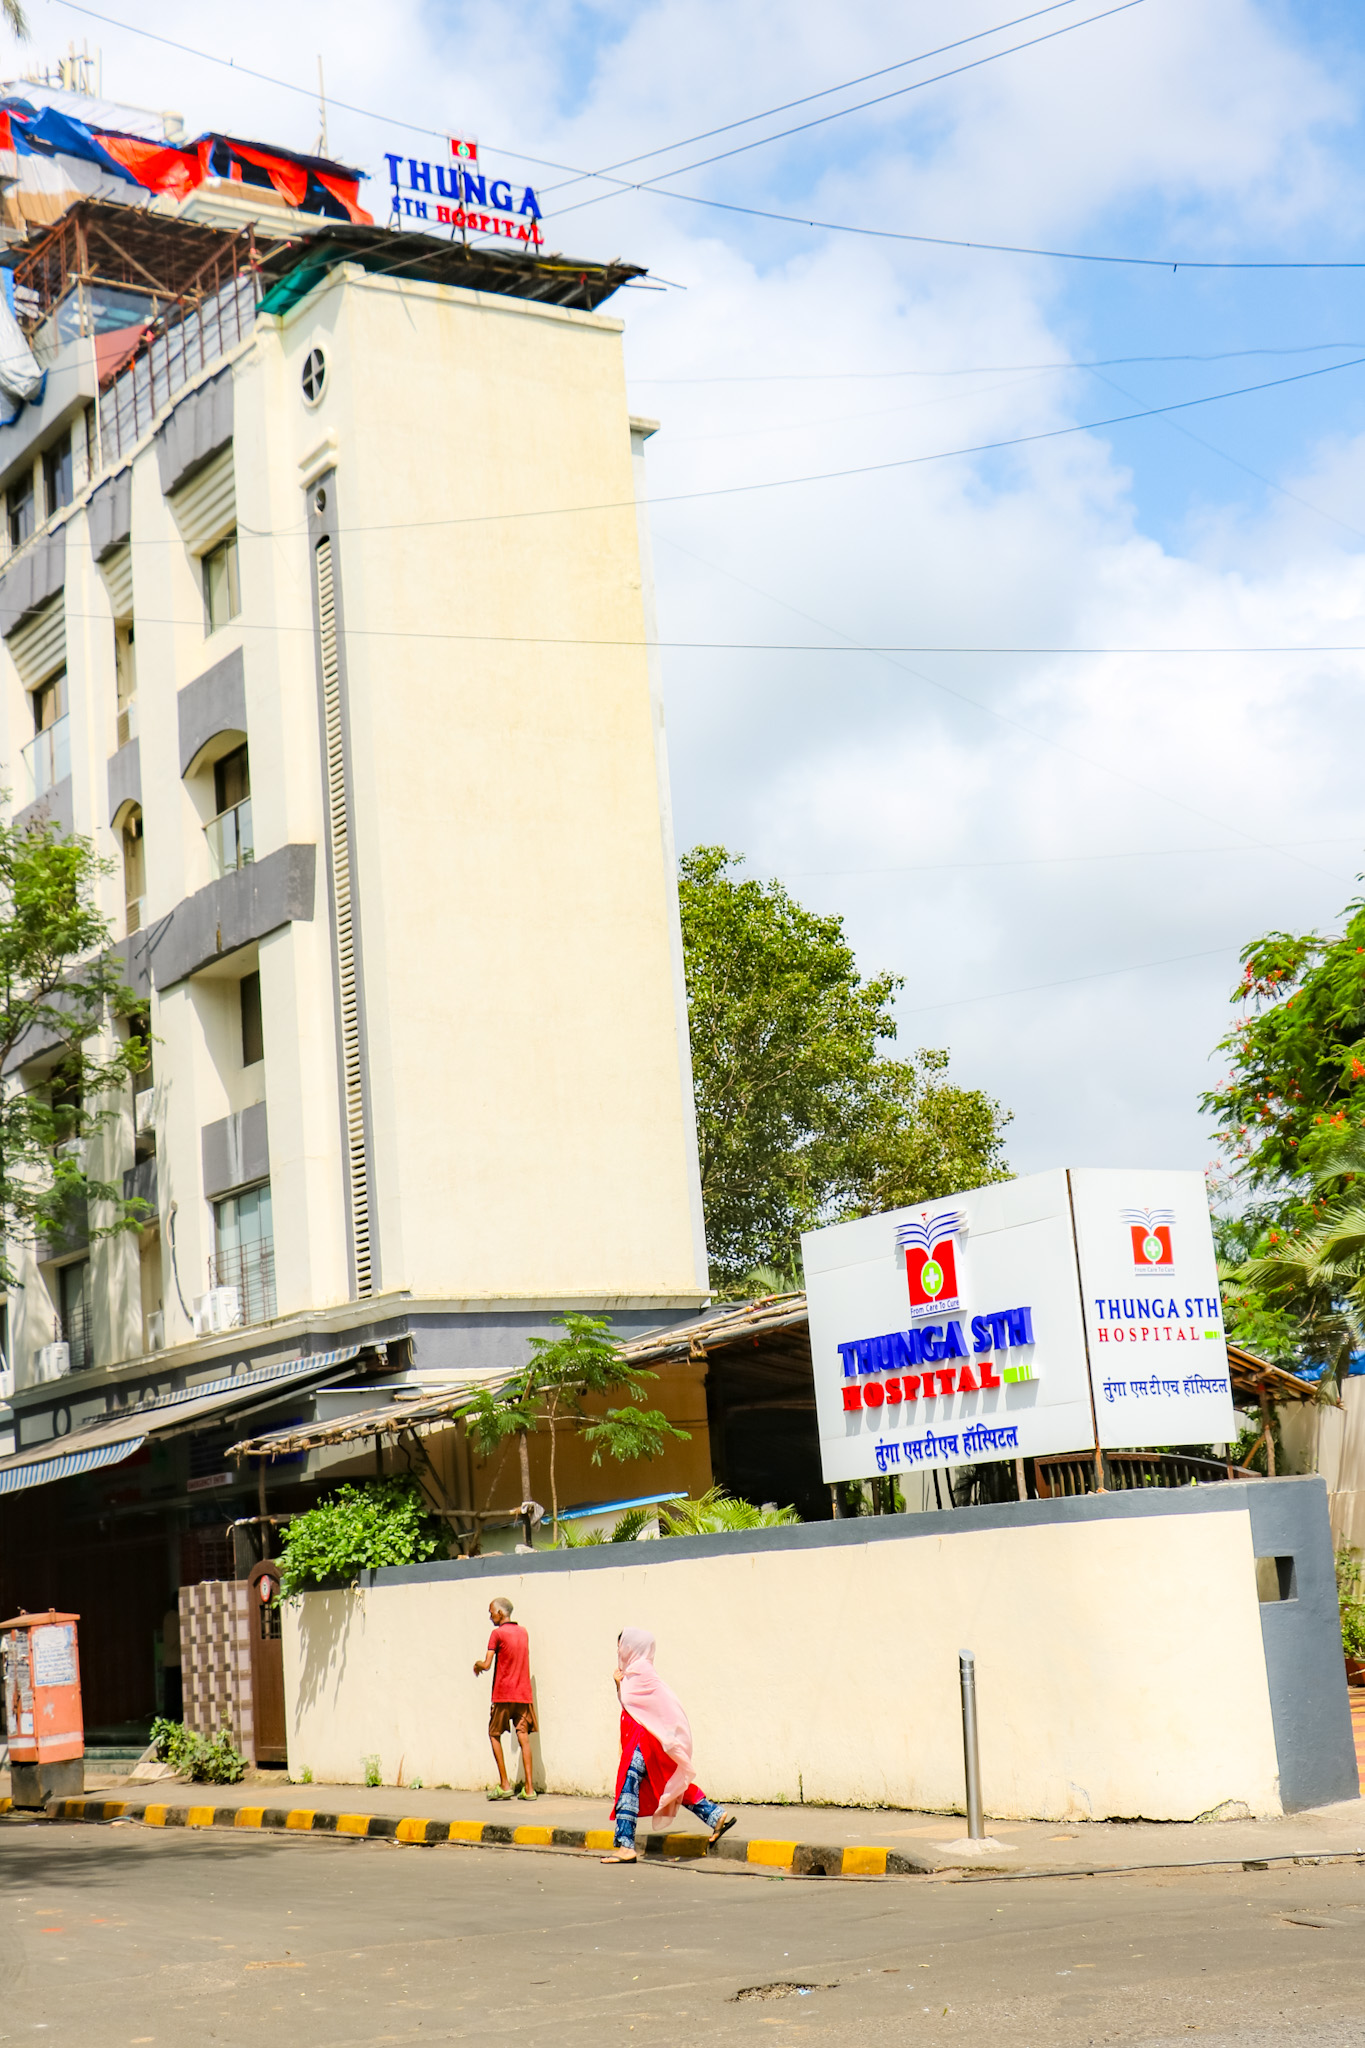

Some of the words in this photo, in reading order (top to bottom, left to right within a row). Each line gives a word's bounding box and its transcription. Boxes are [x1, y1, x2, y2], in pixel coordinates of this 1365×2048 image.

[384, 153, 543, 220] THUNGA
[392, 195, 428, 220] STH
[436, 204, 545, 245] HOSPITAL
[910, 1307, 924, 1316] From
[926, 1303, 938, 1312] Care
[939, 1301, 946, 1309] To
[947, 1299, 959, 1308] Cure
[1095, 1298, 1180, 1320] THUNGA
[1184, 1298, 1219, 1318] STH
[838, 1321, 970, 1377] THUNGA
[971, 1307, 1035, 1353] STH
[1097, 1326, 1200, 1342] HOSPITAL
[841, 1362, 1001, 1411] HOSPITAL
[1103, 1377, 1127, 1402] तुंगा
[1182, 1373, 1228, 1397] हॉस्पिटल
[875, 1438, 900, 1472] तुंगा
[962, 1423, 1019, 1457] हॉस्पिटल
